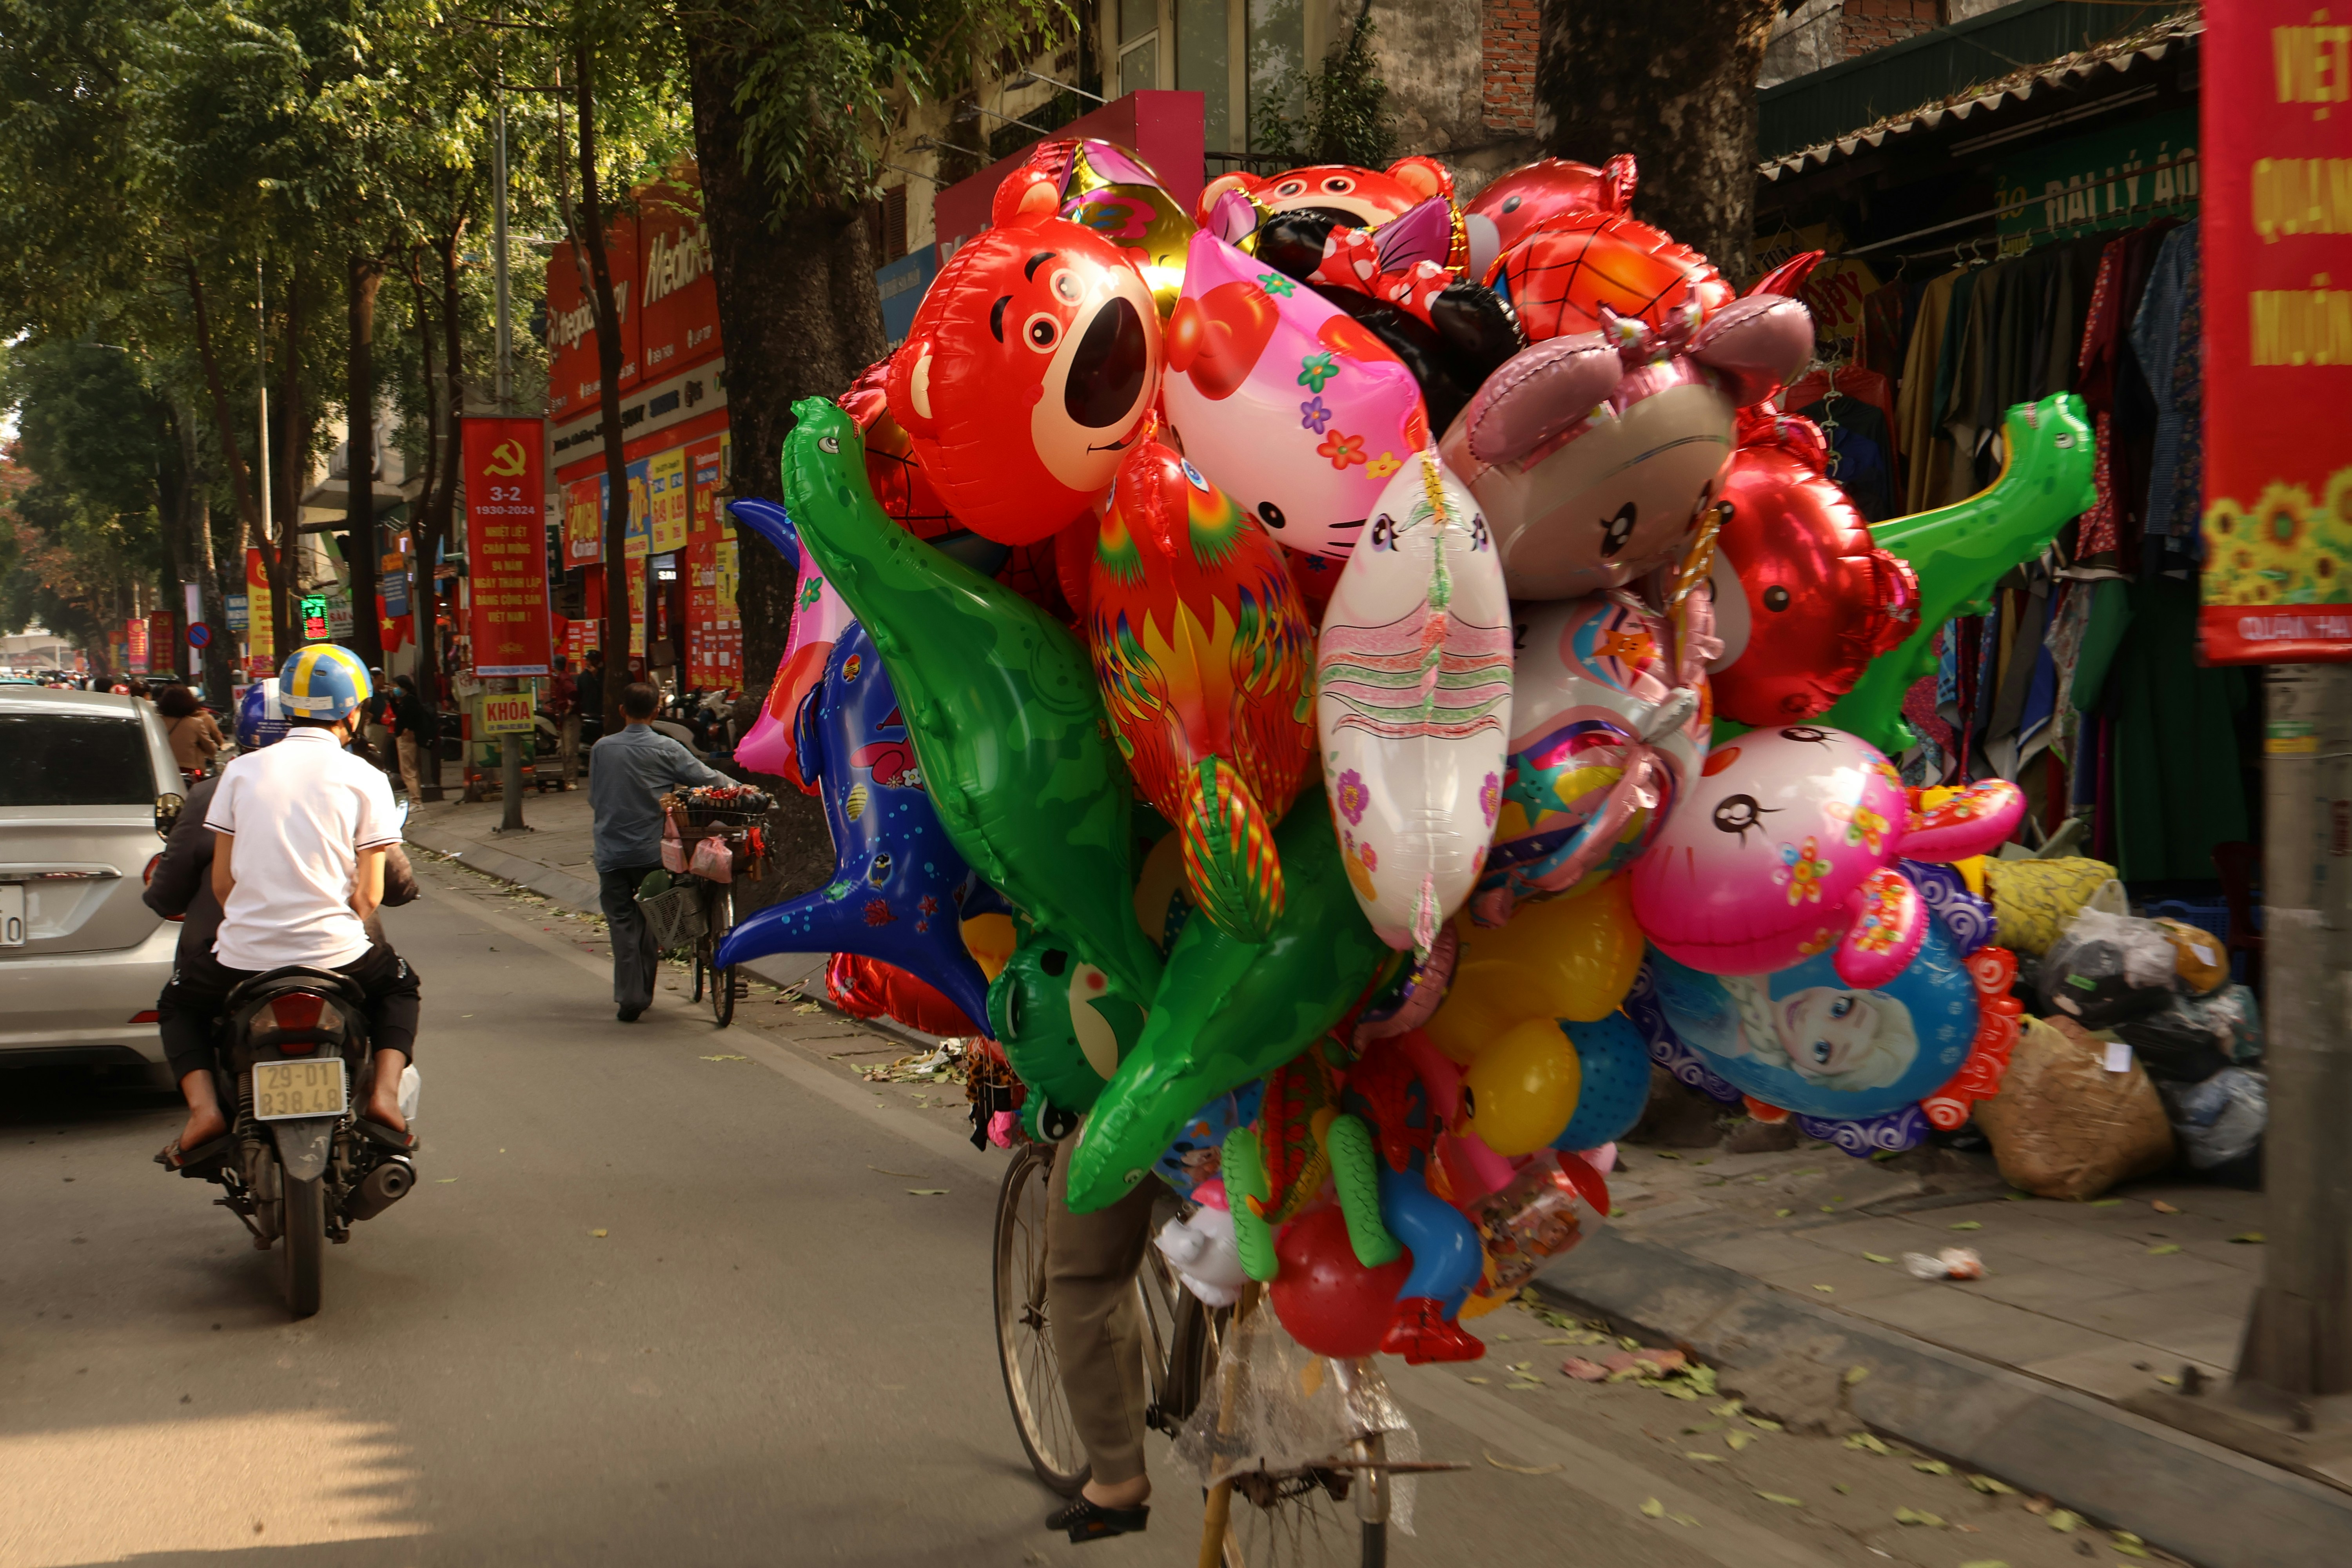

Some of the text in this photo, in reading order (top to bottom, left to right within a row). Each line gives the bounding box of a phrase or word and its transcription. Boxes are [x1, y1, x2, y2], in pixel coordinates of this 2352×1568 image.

[490, 486, 521, 501] 3-2
[475, 506, 535, 515] 1930-2024
[492, 559, 523, 571] 94 NĂM
[487, 610, 505, 625] VIỆT
[507, 611, 526, 622] NAM
[486, 698, 531, 722] KHÓA
[268, 1063, 328, 1090] 29-D1
[261, 1088, 339, 1116] 838.48
